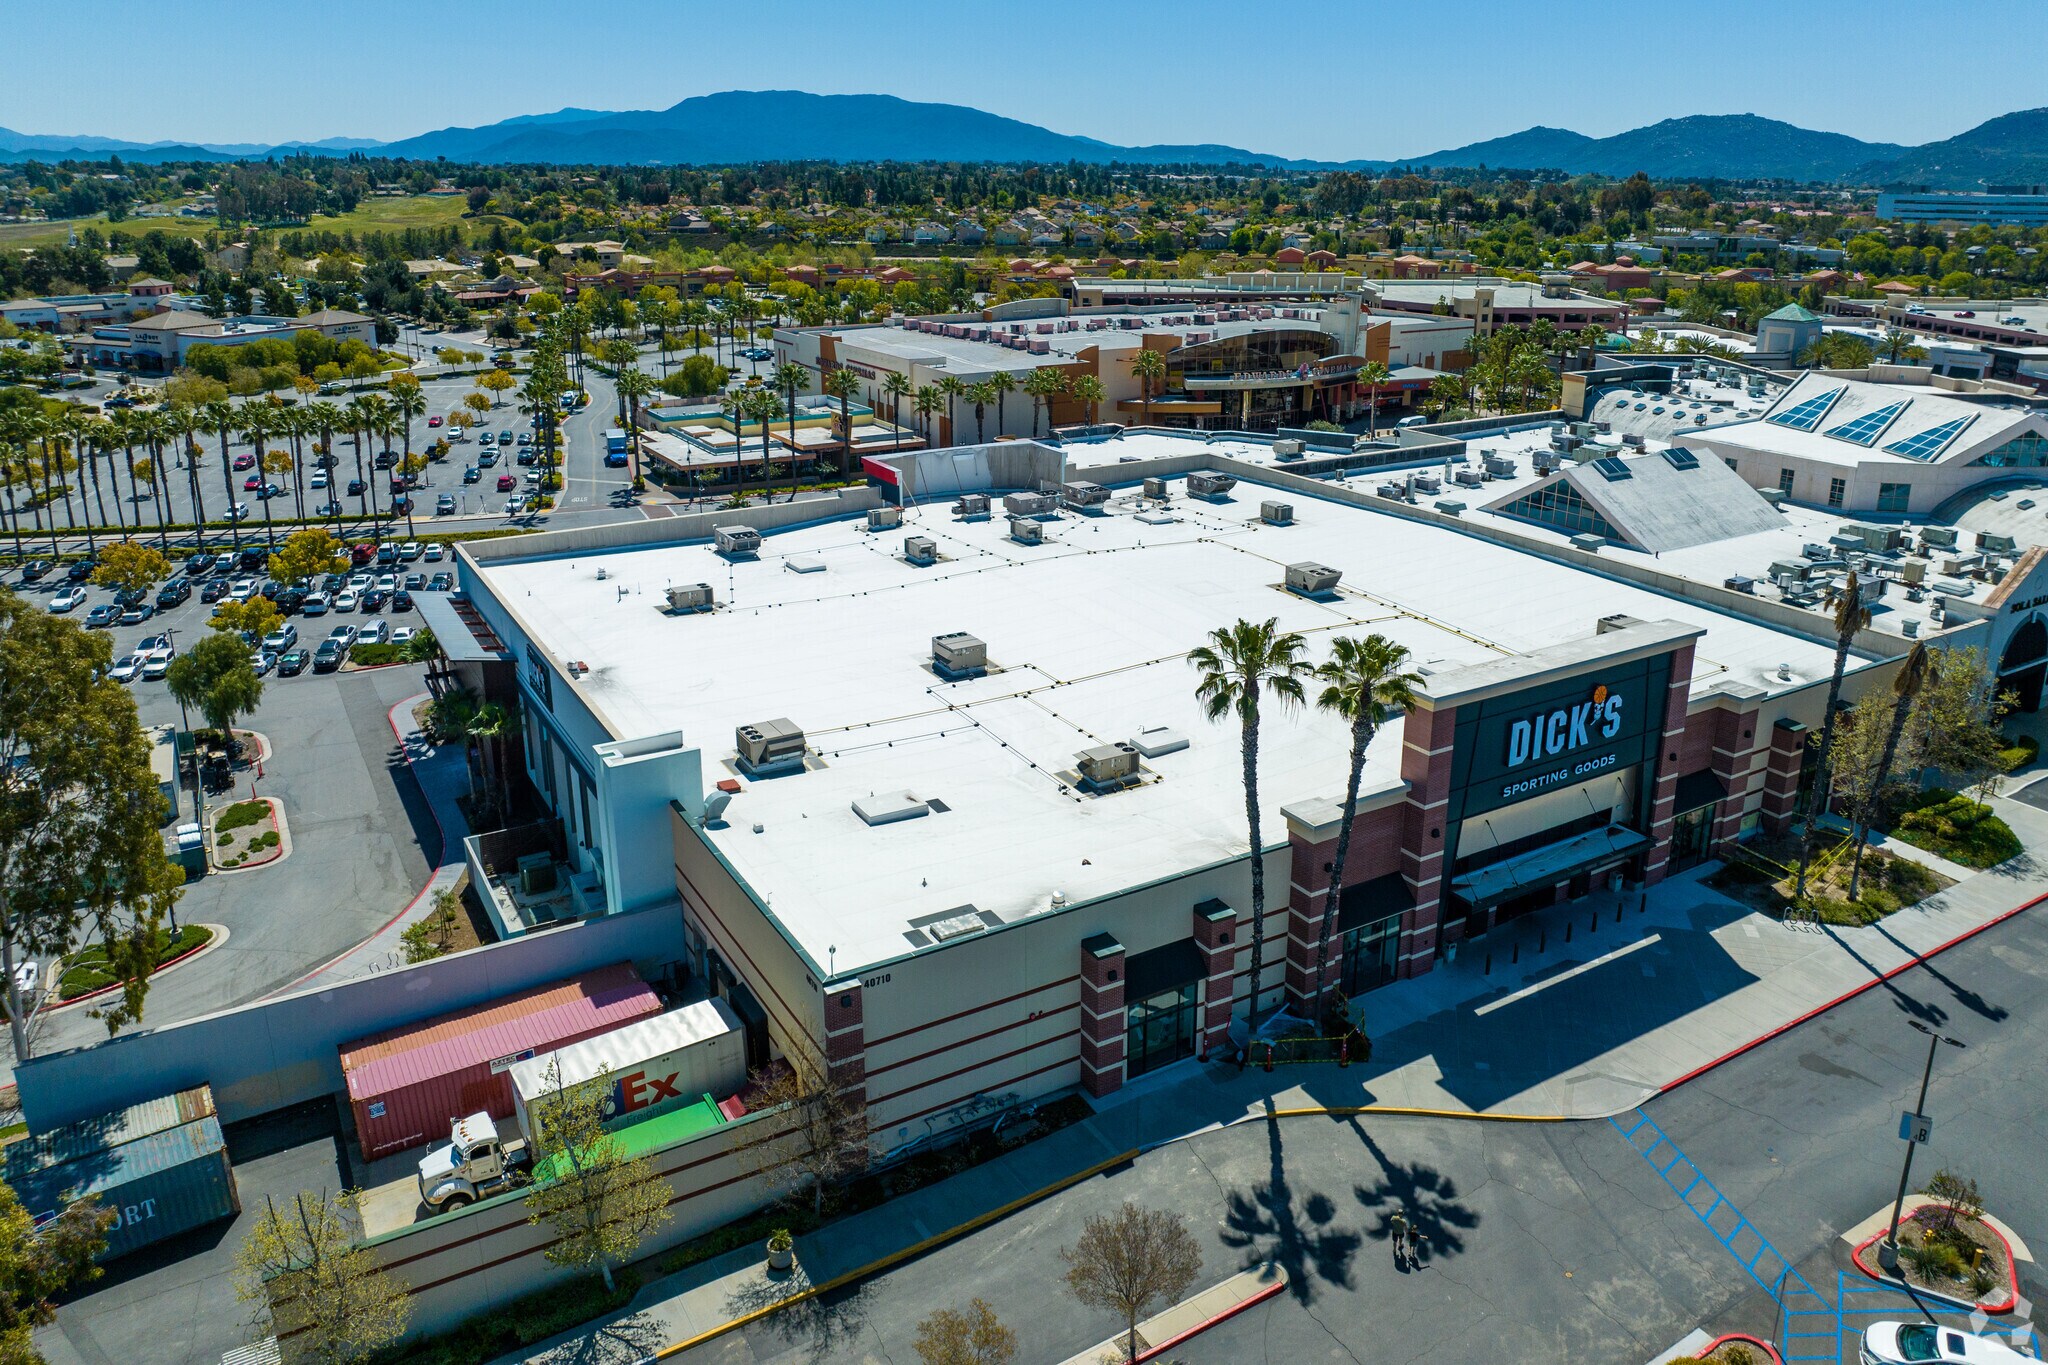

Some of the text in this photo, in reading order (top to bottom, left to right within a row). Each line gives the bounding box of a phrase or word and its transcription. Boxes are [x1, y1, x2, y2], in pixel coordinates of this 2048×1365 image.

[1233, 370, 1292, 381] EDWARDS
[1508, 694, 1623, 768] DICK'S
[1503, 754, 1616, 798] SPORTING GOODS
[864, 973, 891, 989] 40710
[491, 1056, 516, 1068] AZTEC
[626, 1105, 663, 1124] Freight
